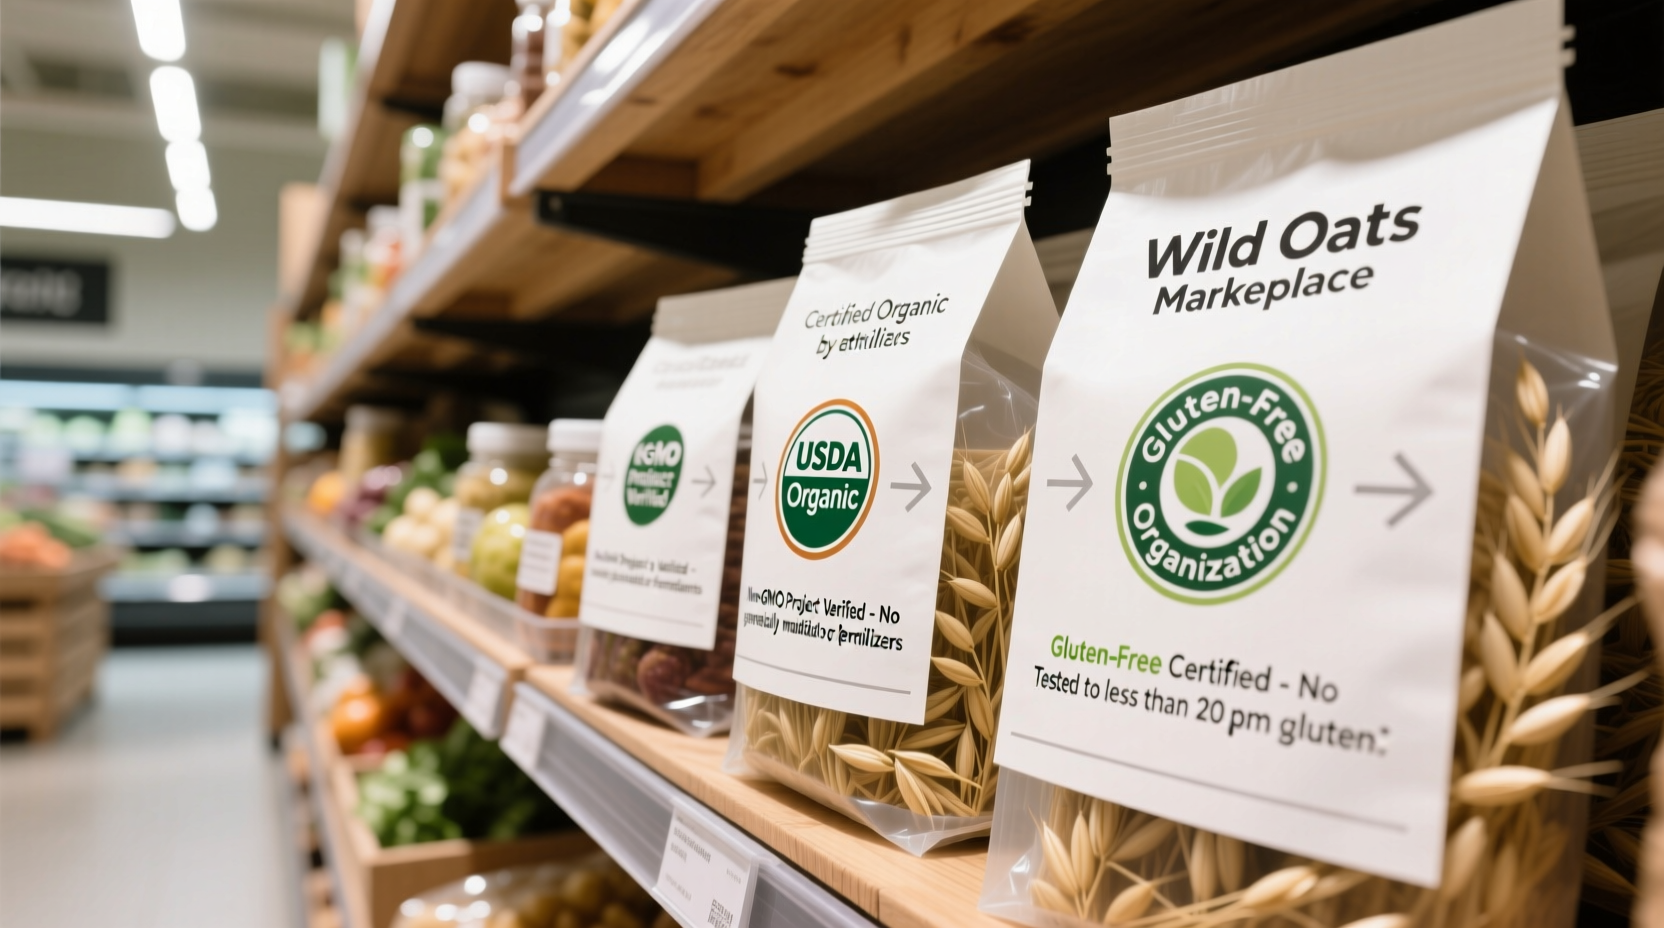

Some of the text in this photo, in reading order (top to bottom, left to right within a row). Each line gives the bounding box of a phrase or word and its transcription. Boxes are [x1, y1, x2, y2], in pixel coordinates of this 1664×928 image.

[1149, 203, 1422, 279] Wild Oats
[877, 293, 949, 324] Organic
[1153, 266, 1374, 315] Markeplace
[1142, 386, 1306, 464] Gluten-Free
[796, 440, 862, 472] USDA
[787, 482, 859, 516] Organic
[1133, 502, 1297, 582] Organization
[879, 605, 900, 624] No
[1051, 635, 1162, 674] Gluten-Free
[1169, 654, 1271, 692] Certified
[1299, 673, 1338, 703] No
[1035, 665, 1080, 694] Tested
[1084, 678, 1100, 699] to
[1105, 679, 1138, 707] less
[1144, 687, 1188, 717] than
[1196, 697, 1224, 724] 20
[1228, 709, 1270, 736] pm
